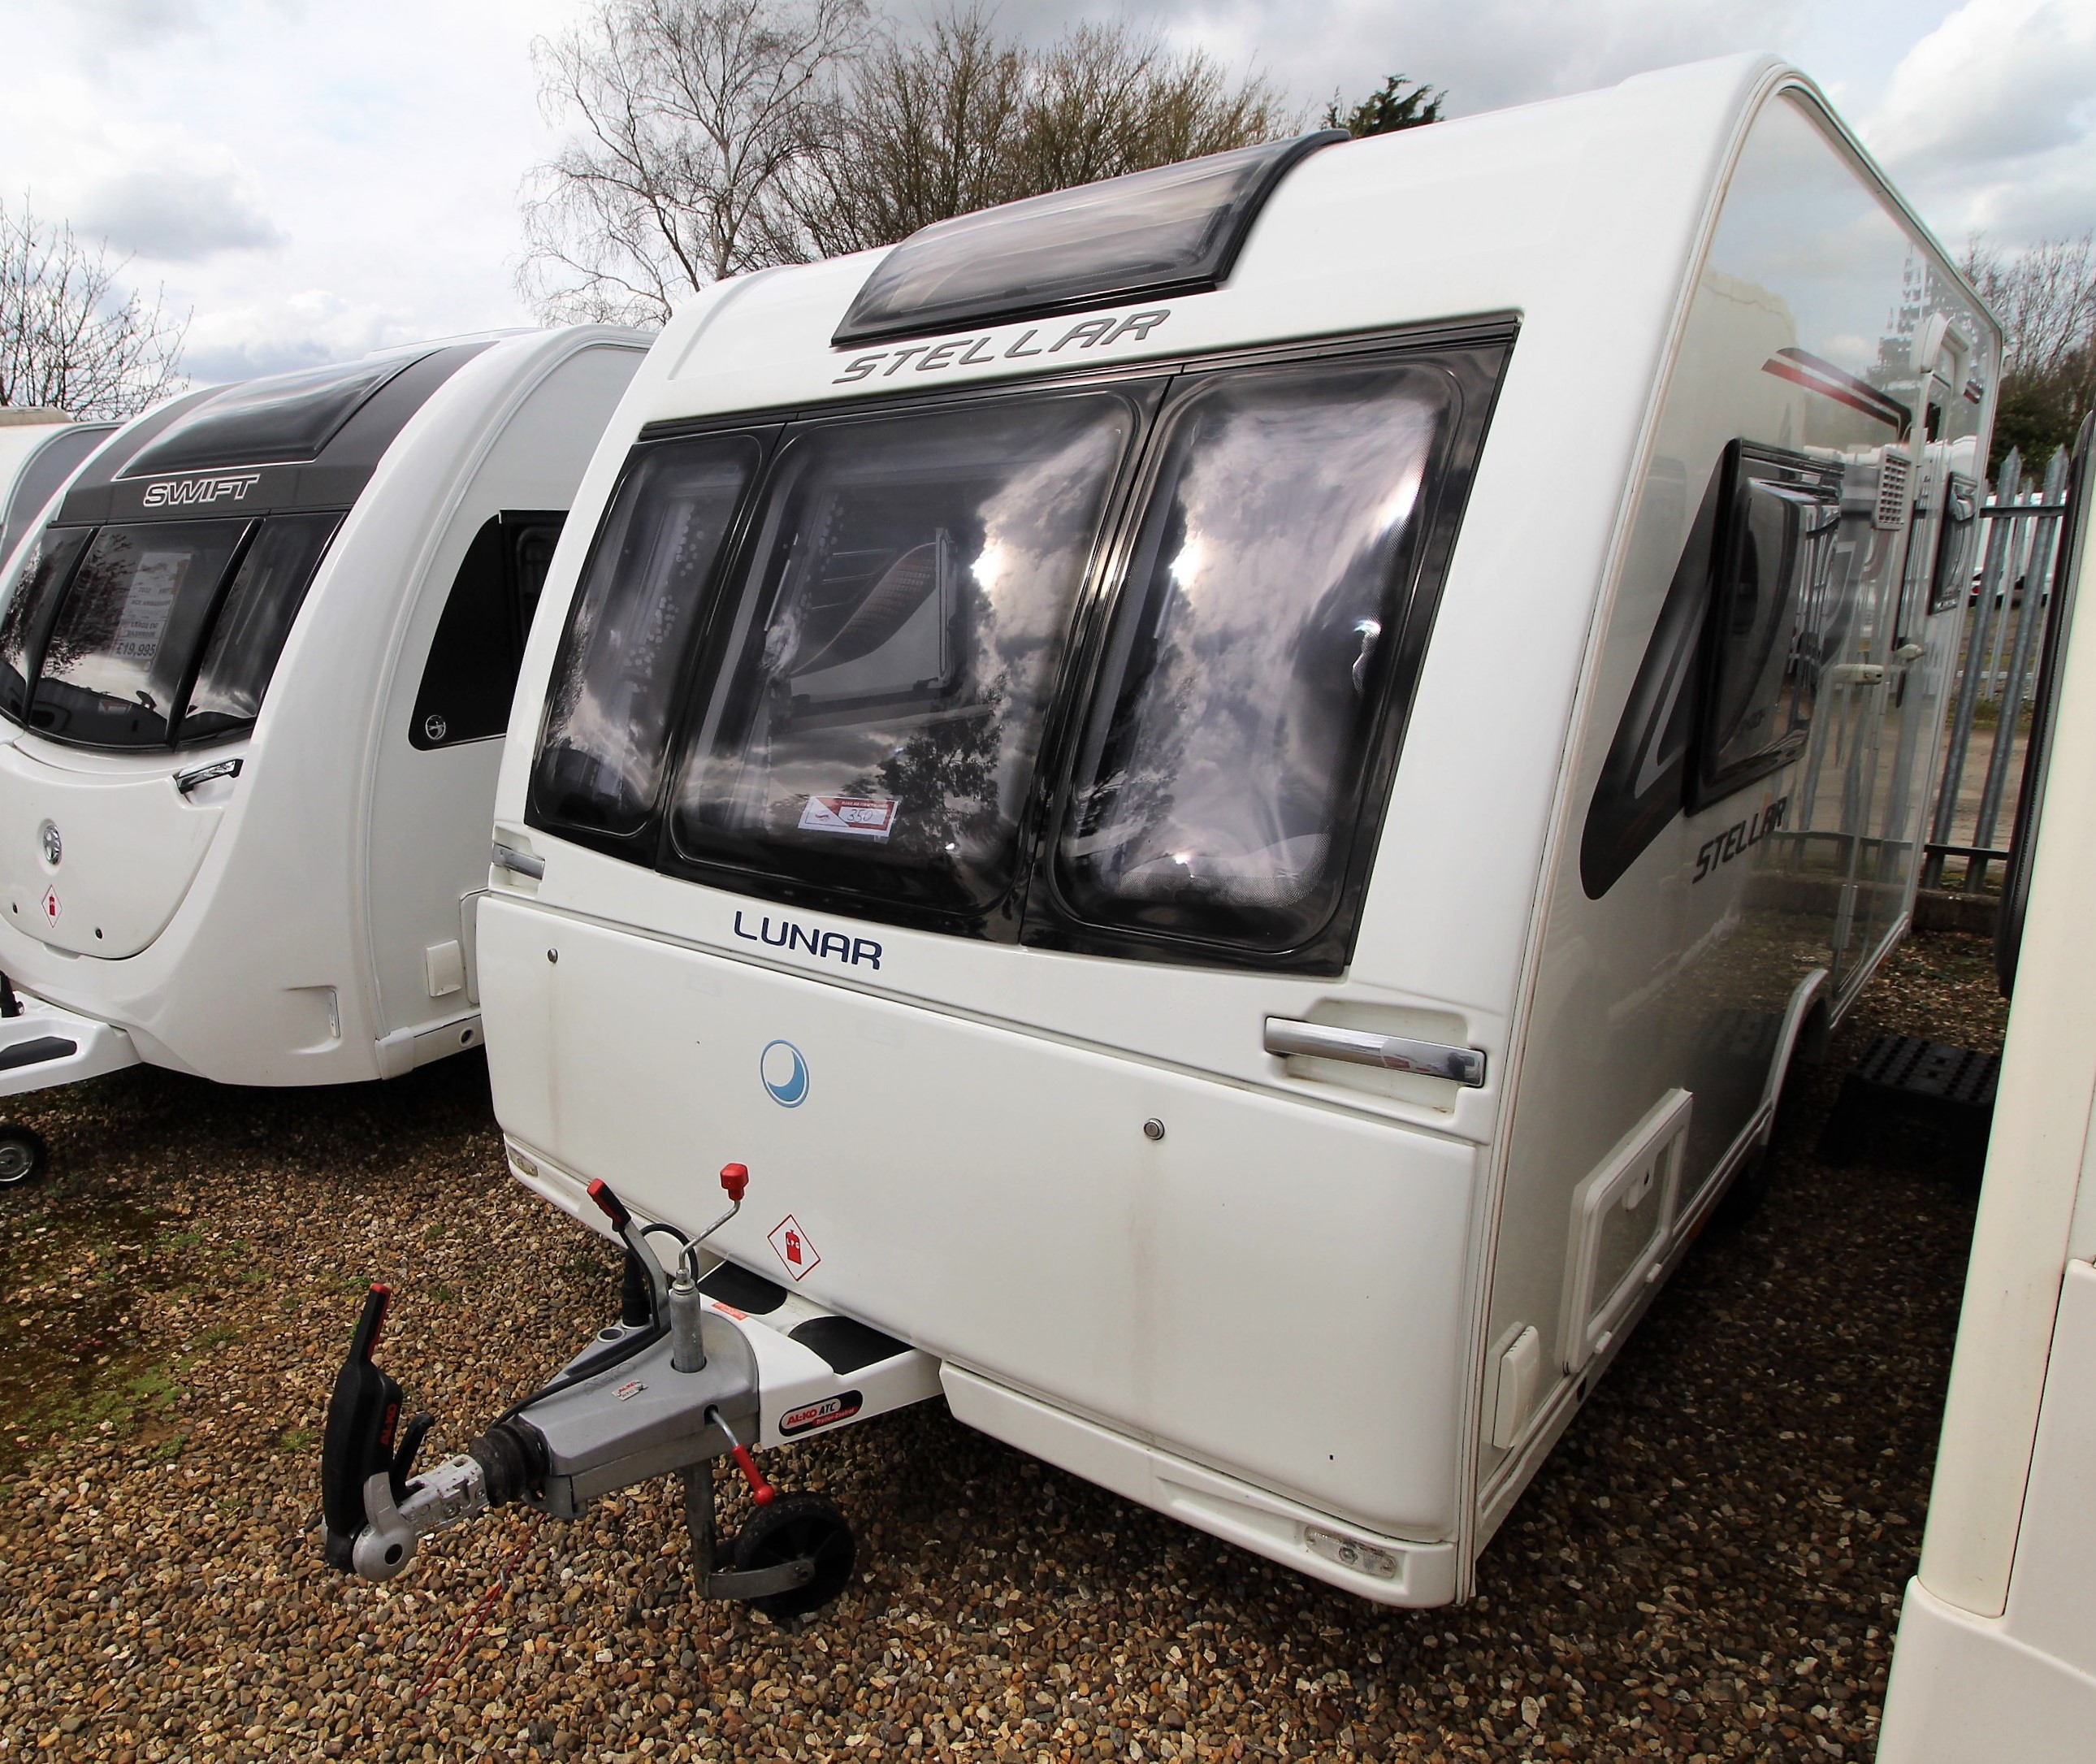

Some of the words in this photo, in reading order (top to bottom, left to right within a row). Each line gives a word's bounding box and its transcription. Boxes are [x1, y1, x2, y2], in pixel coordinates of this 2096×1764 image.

[832, 309, 1171, 384] STELLAR
[143, 474, 261, 507] SWIFT
[116, 643, 157, 657] £19,995
[847, 808, 873, 822] 350
[1692, 795, 1787, 884] STELLAR
[734, 911, 882, 970] LUNAR
[786, 1237, 800, 1250] LPG
[786, 1409, 817, 1425] AL-KO
[819, 1402, 837, 1415] ATC
